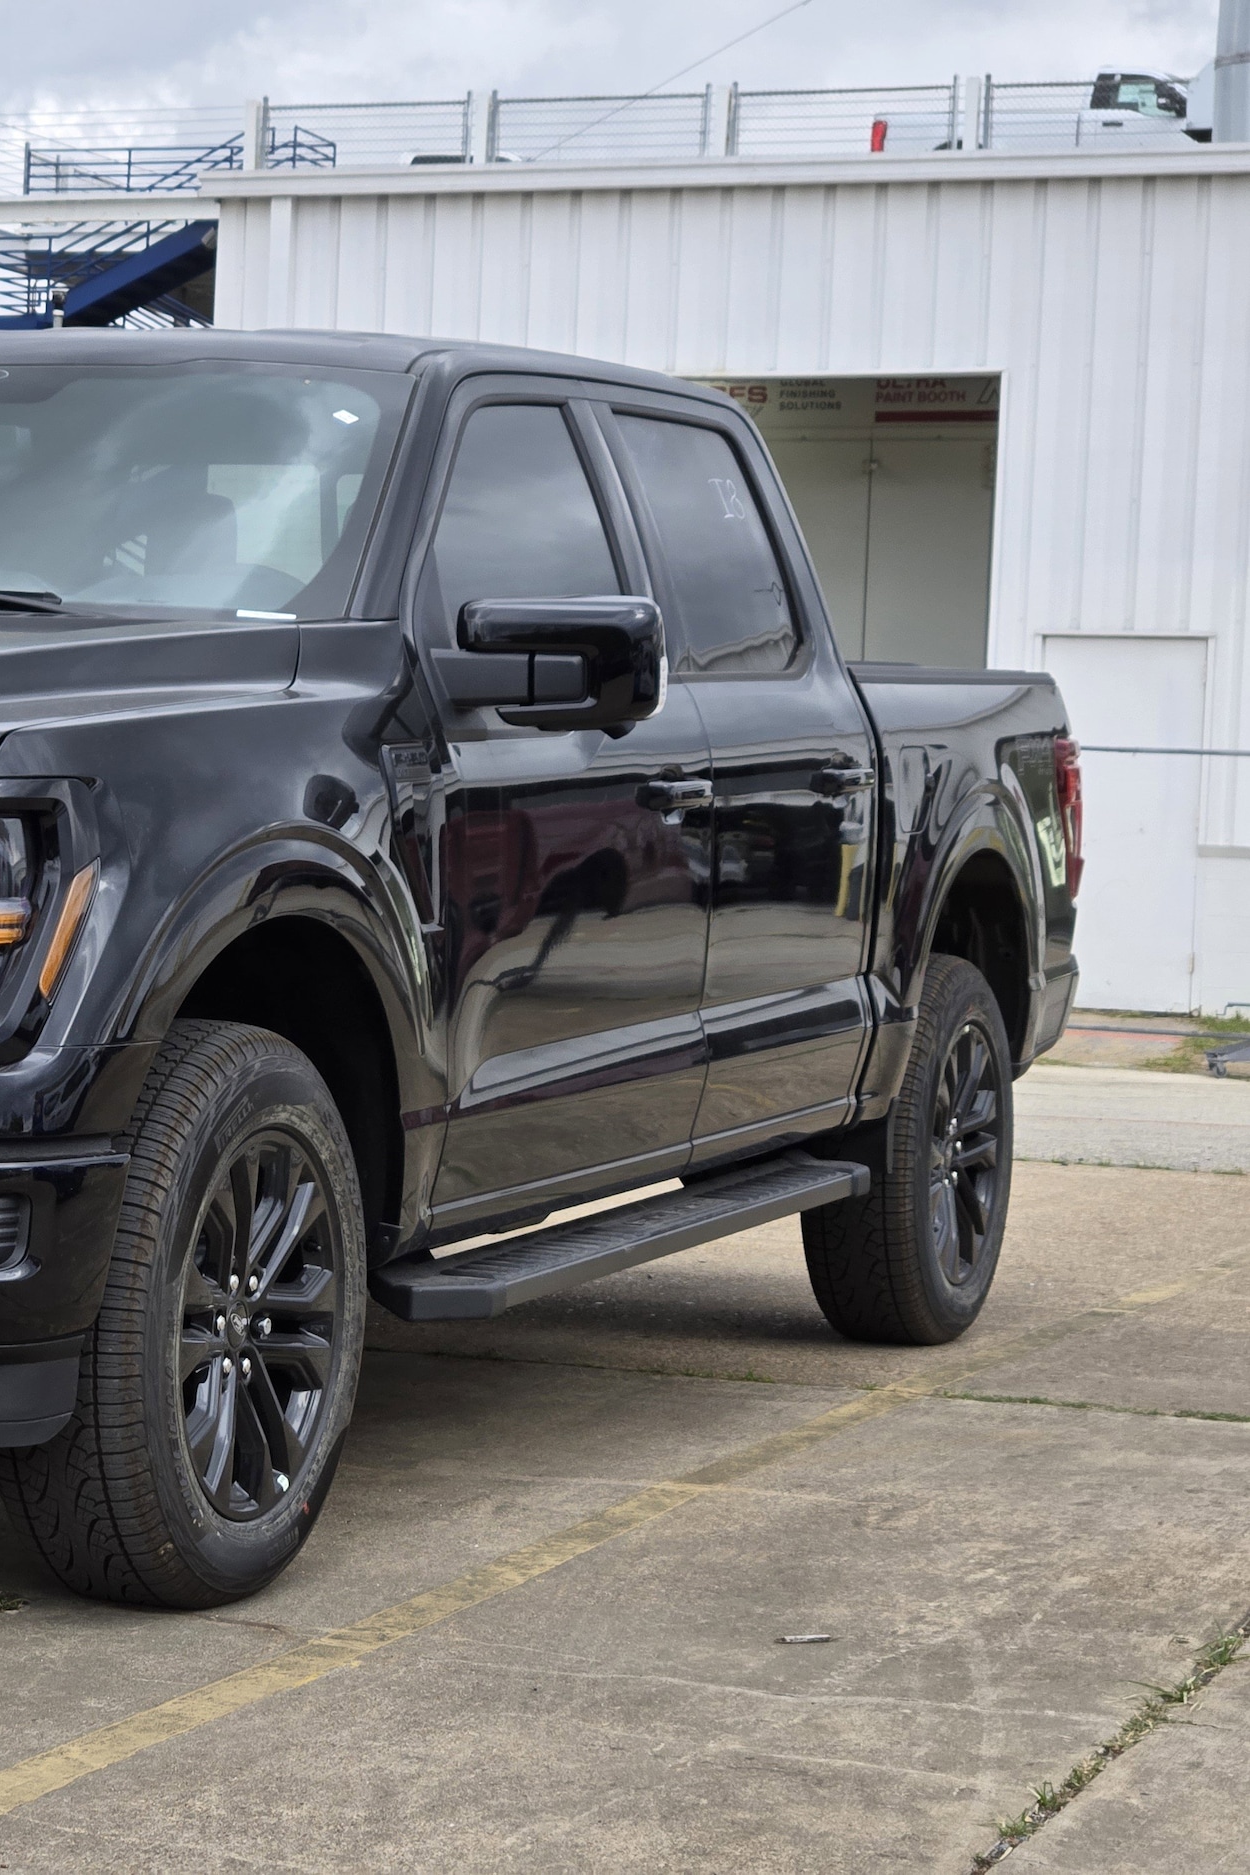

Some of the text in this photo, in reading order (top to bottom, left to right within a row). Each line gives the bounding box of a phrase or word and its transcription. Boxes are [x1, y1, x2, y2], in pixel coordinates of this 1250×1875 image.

[711, 385, 768, 403] FS
[779, 389, 836, 399] FINISHING
[876, 391, 967, 403] PAINT BOOTH
[779, 401, 842, 411] SOLUTIONS
